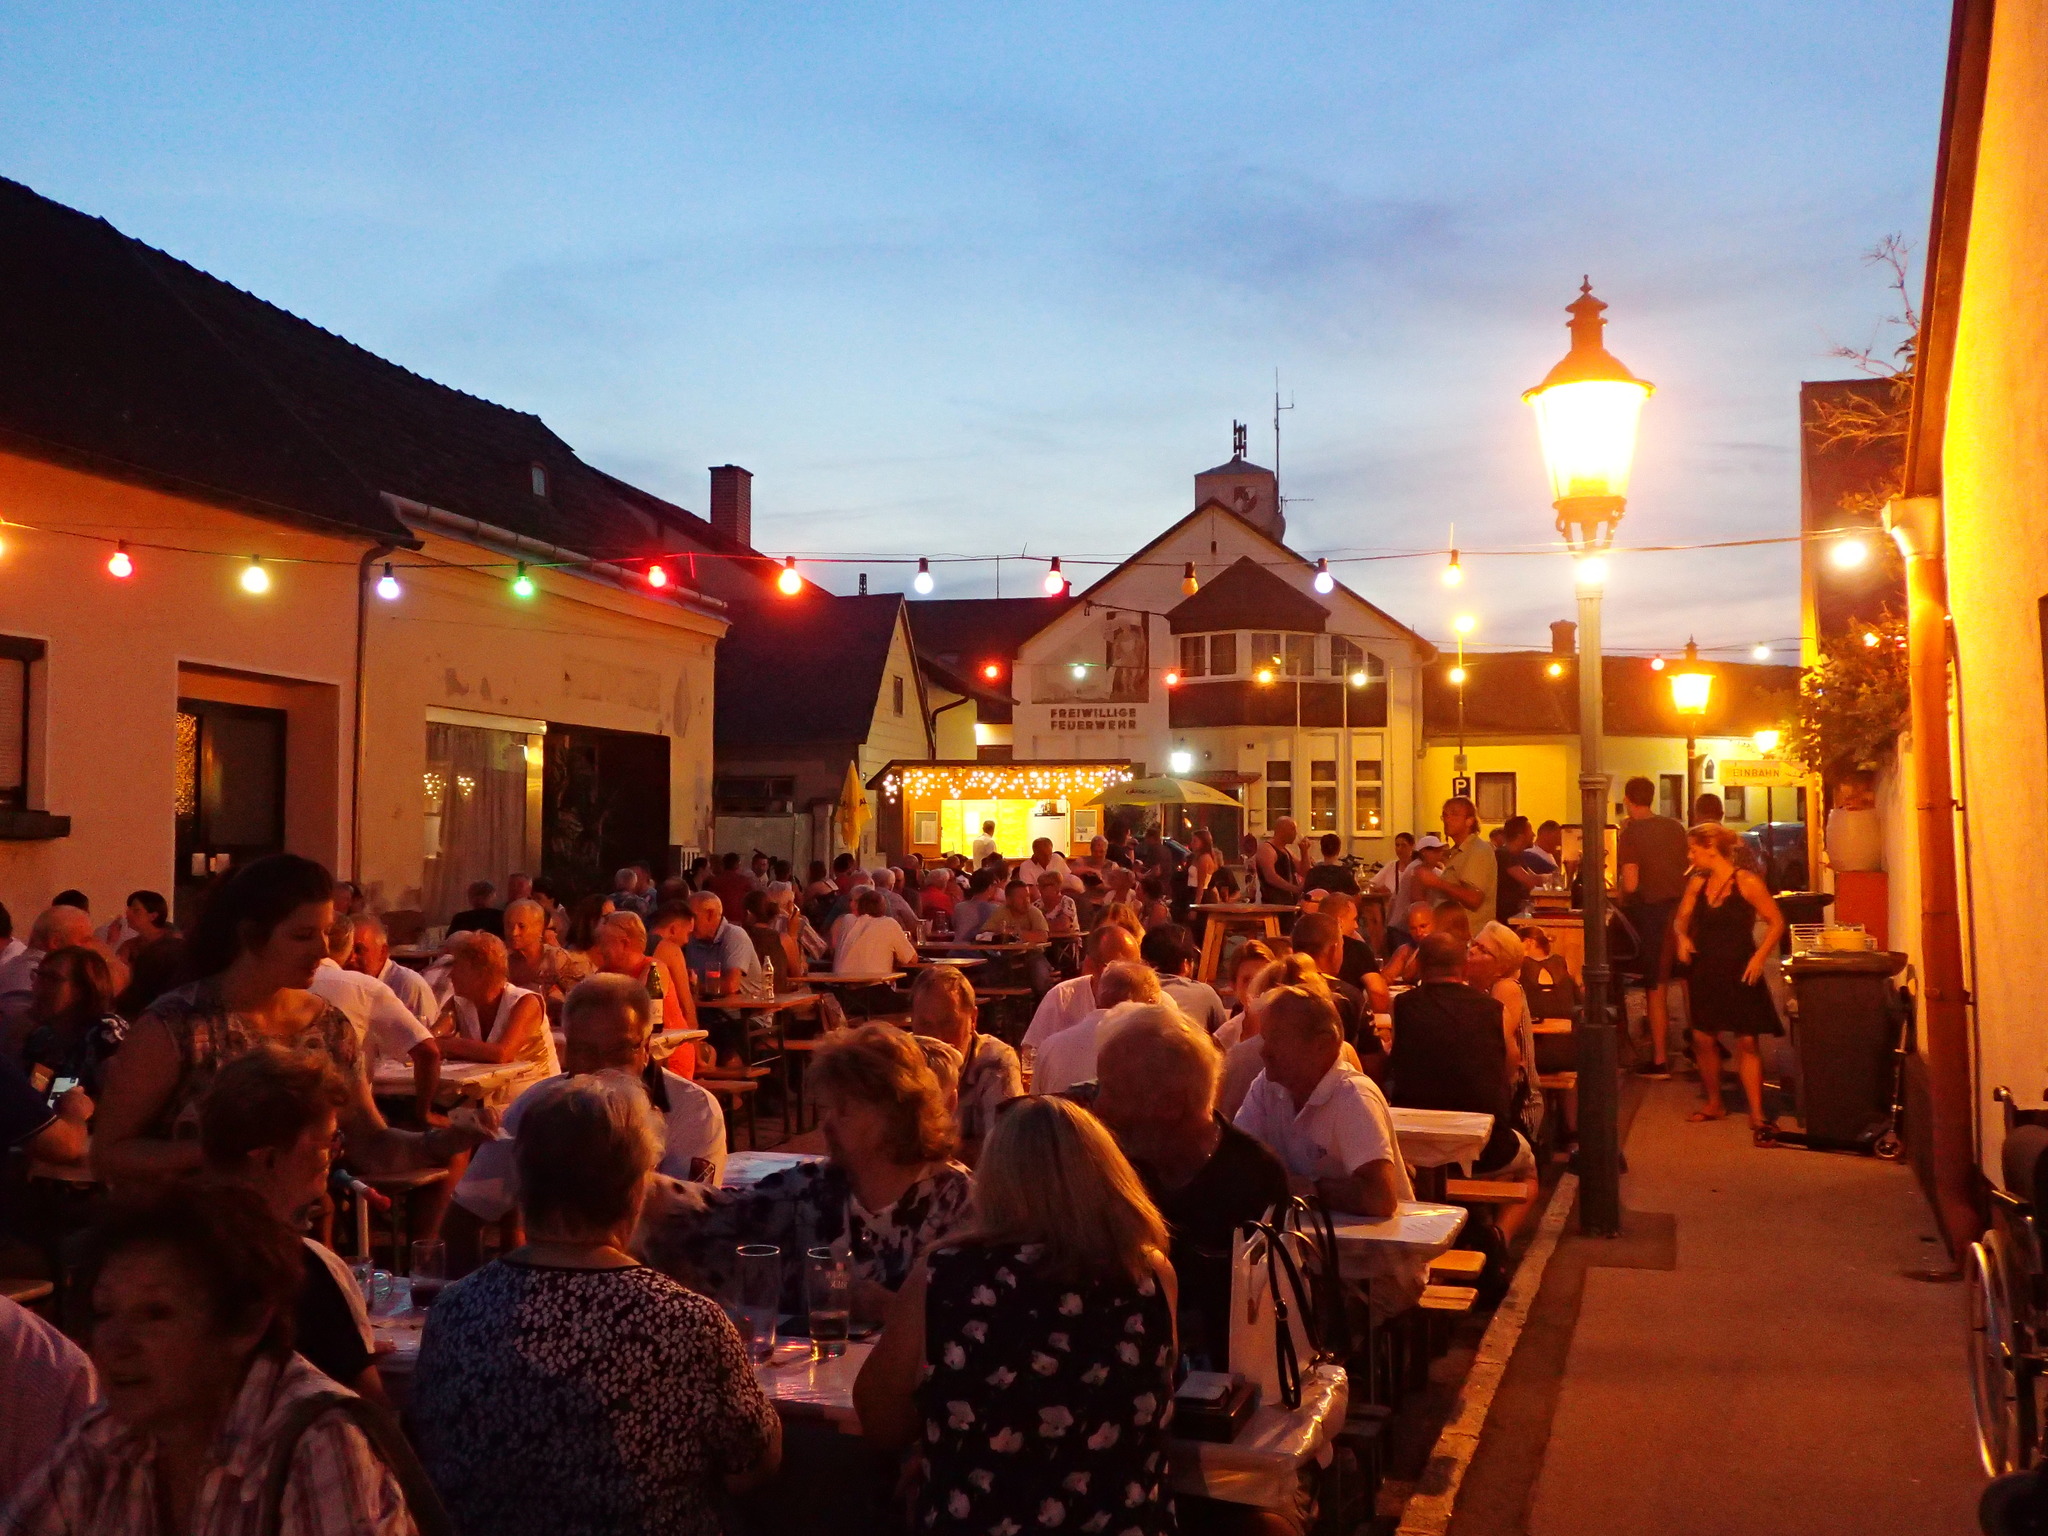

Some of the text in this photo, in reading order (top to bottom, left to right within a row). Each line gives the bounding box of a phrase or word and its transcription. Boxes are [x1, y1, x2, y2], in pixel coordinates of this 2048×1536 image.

[1050, 708, 1137, 719] FREIWILLIGE
[1050, 719, 1137, 730] FEUERWEHR
[1733, 769, 1780, 777] EINBAHN
[1455, 779, 1467, 795] P
